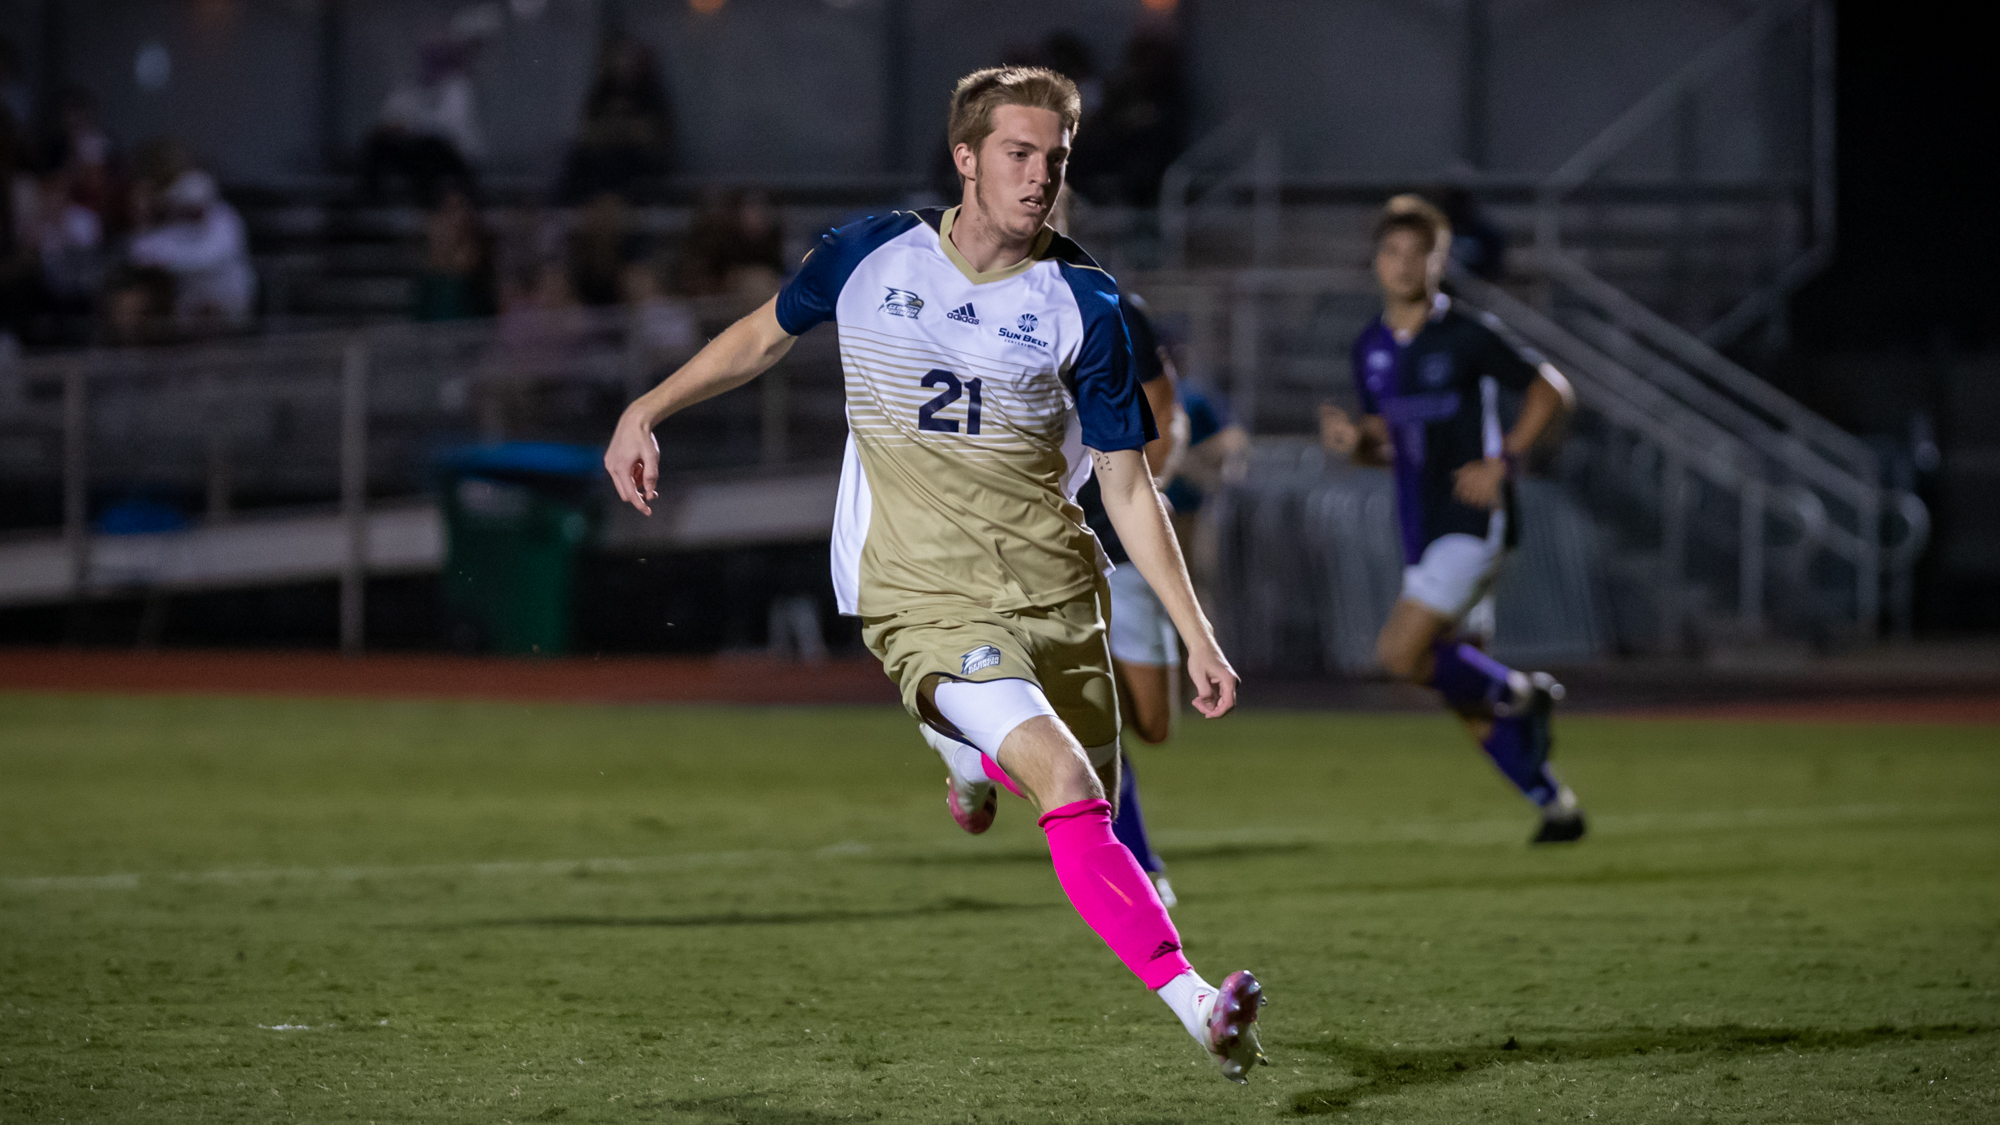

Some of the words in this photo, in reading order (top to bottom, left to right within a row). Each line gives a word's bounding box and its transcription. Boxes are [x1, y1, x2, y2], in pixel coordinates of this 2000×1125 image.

[946, 311, 980, 325] adidas
[998, 327, 1021, 340] SUN
[1022, 334, 1049, 348] BELT
[918, 368, 982, 435] 21
